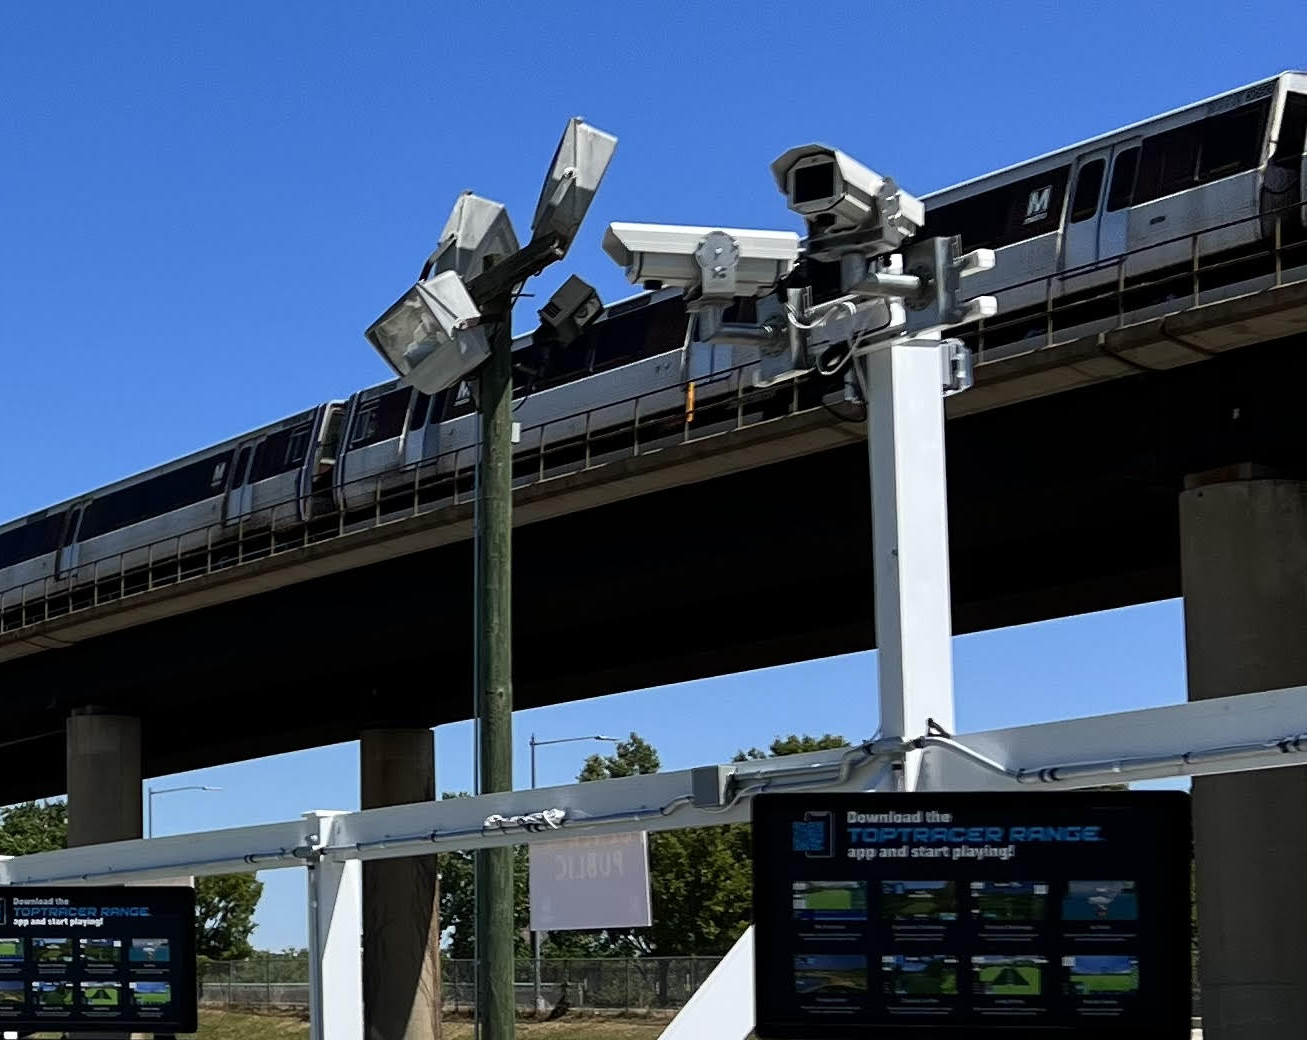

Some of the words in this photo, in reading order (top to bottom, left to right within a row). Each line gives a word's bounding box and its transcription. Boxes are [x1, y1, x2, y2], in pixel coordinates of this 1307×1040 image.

[1027, 187, 1050, 216] M
[847, 811, 922, 823] Download
[924, 811, 952, 823] the
[847, 827, 1003, 843] TOPTRACER
[1010, 826, 1102, 842] RANGE
[847, 847, 877, 860] app
[879, 846, 910, 858] and
[911, 846, 950, 858] start
[952, 845, 1015, 860] playing!
[13, 907, 97, 917] TOPTRACER
[100, 907, 149, 917] RANGE
